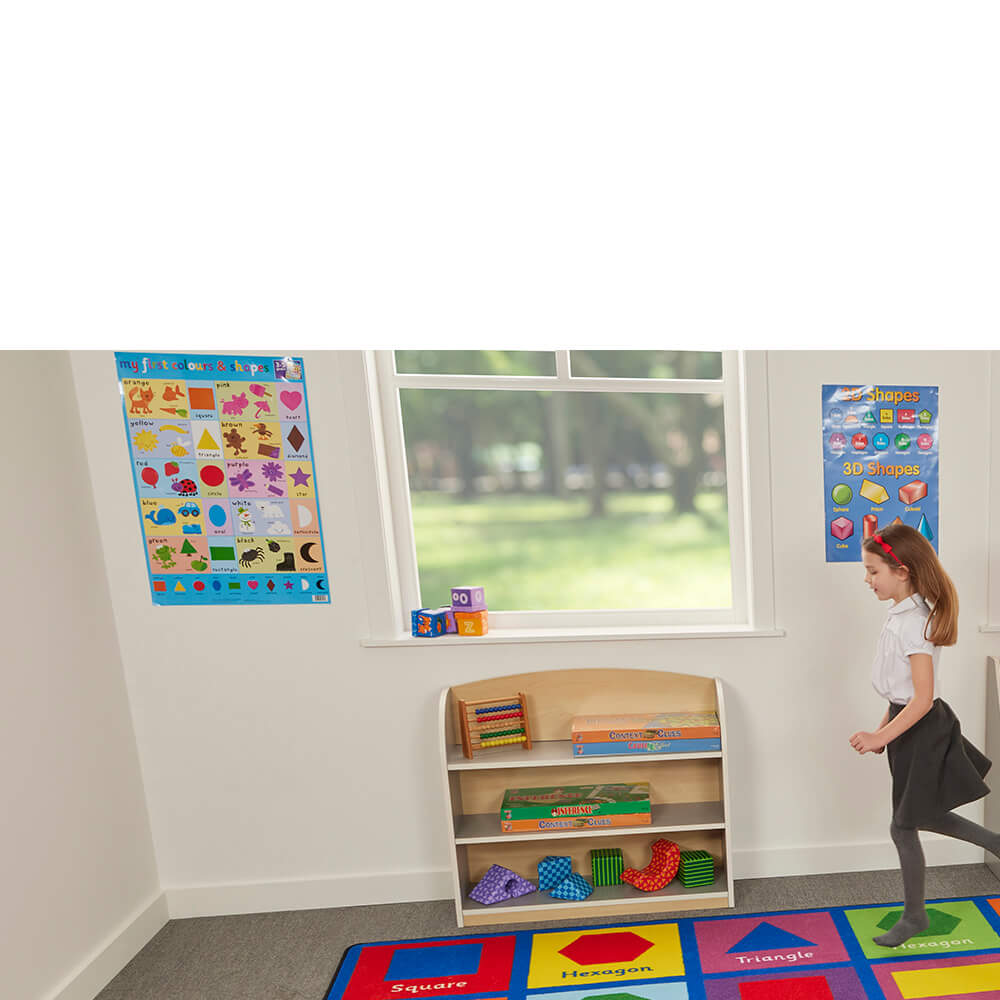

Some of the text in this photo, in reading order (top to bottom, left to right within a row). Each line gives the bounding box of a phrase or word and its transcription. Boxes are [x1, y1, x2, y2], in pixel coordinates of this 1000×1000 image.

[120, 361, 139, 373] my
[142, 357, 168, 373] first
[172, 359, 214, 371] colours
[230, 360, 269, 376] shapes
[866, 387, 920, 406] Shapes
[843, 461, 920, 479] 3D Shapes
[735, 951, 814, 964] Triangle
[559, 964, 656, 982] Hexagon
[390, 980, 470, 996] Square
